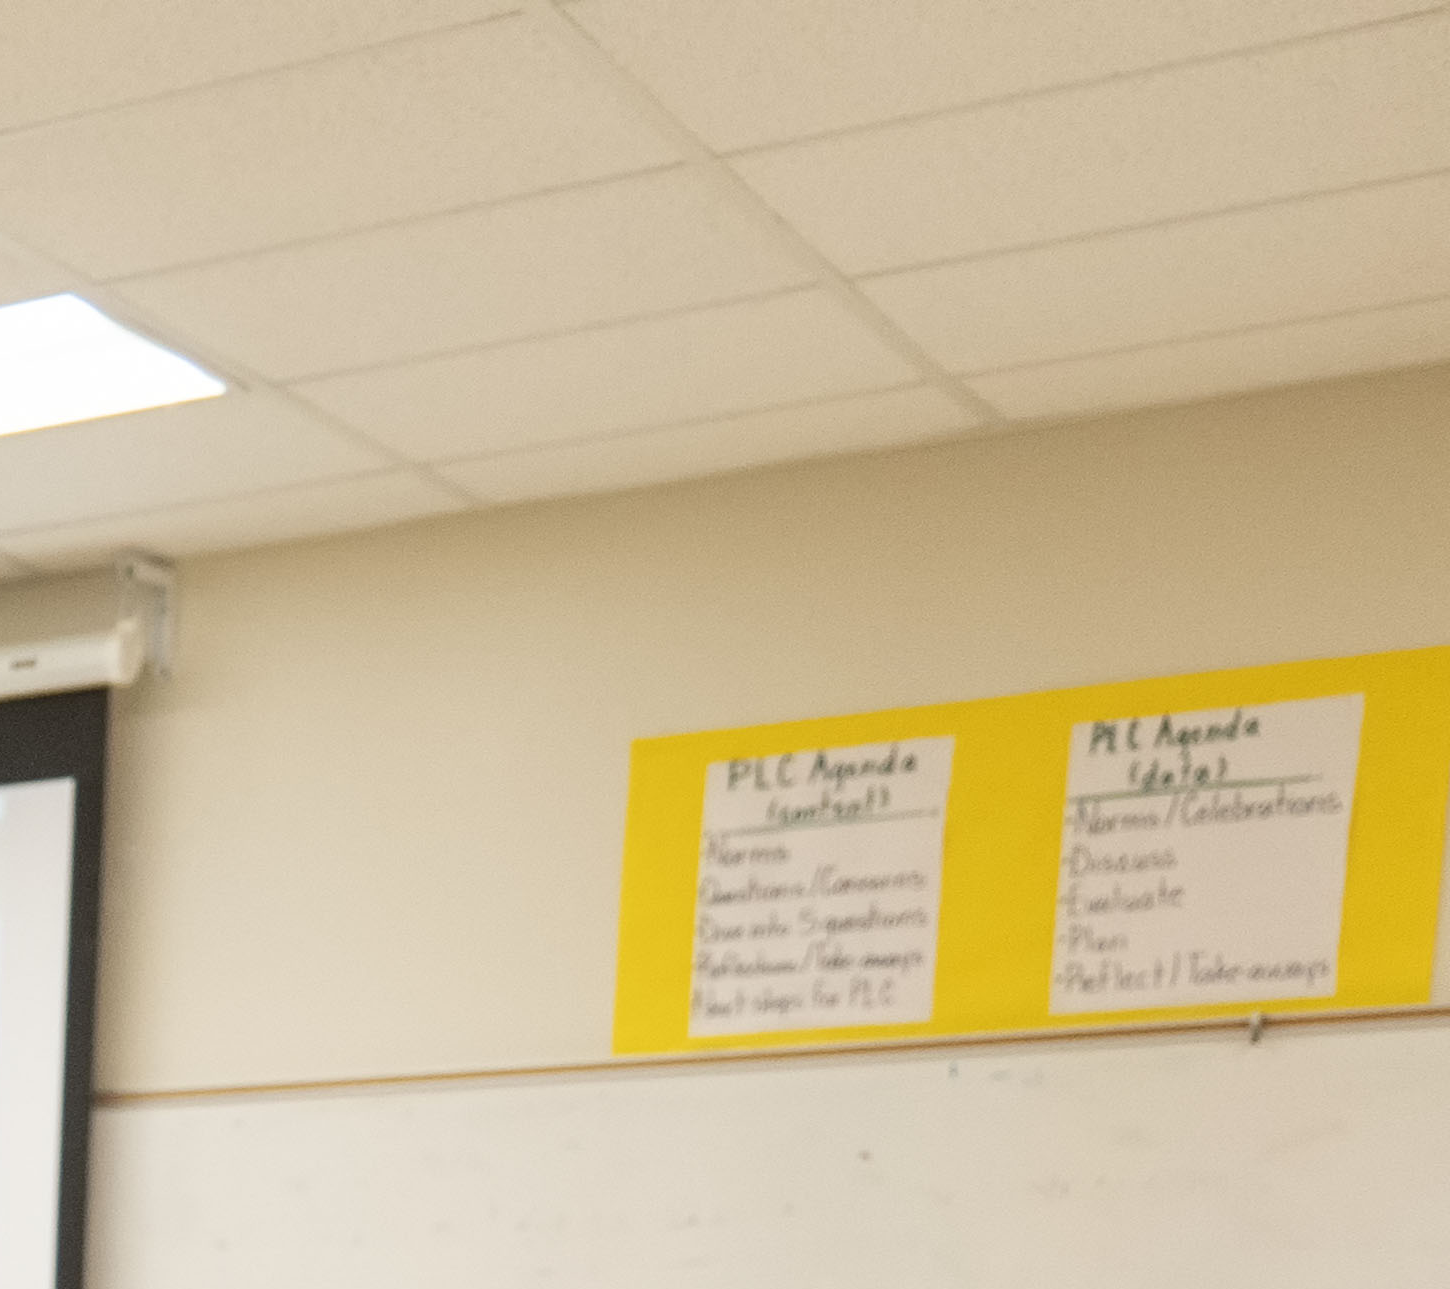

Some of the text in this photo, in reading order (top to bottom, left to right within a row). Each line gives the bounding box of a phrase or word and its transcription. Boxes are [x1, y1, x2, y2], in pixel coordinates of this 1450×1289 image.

[1154, 706, 1261, 757] Agenda
[727, 742, 918, 791] PLC Agenda
